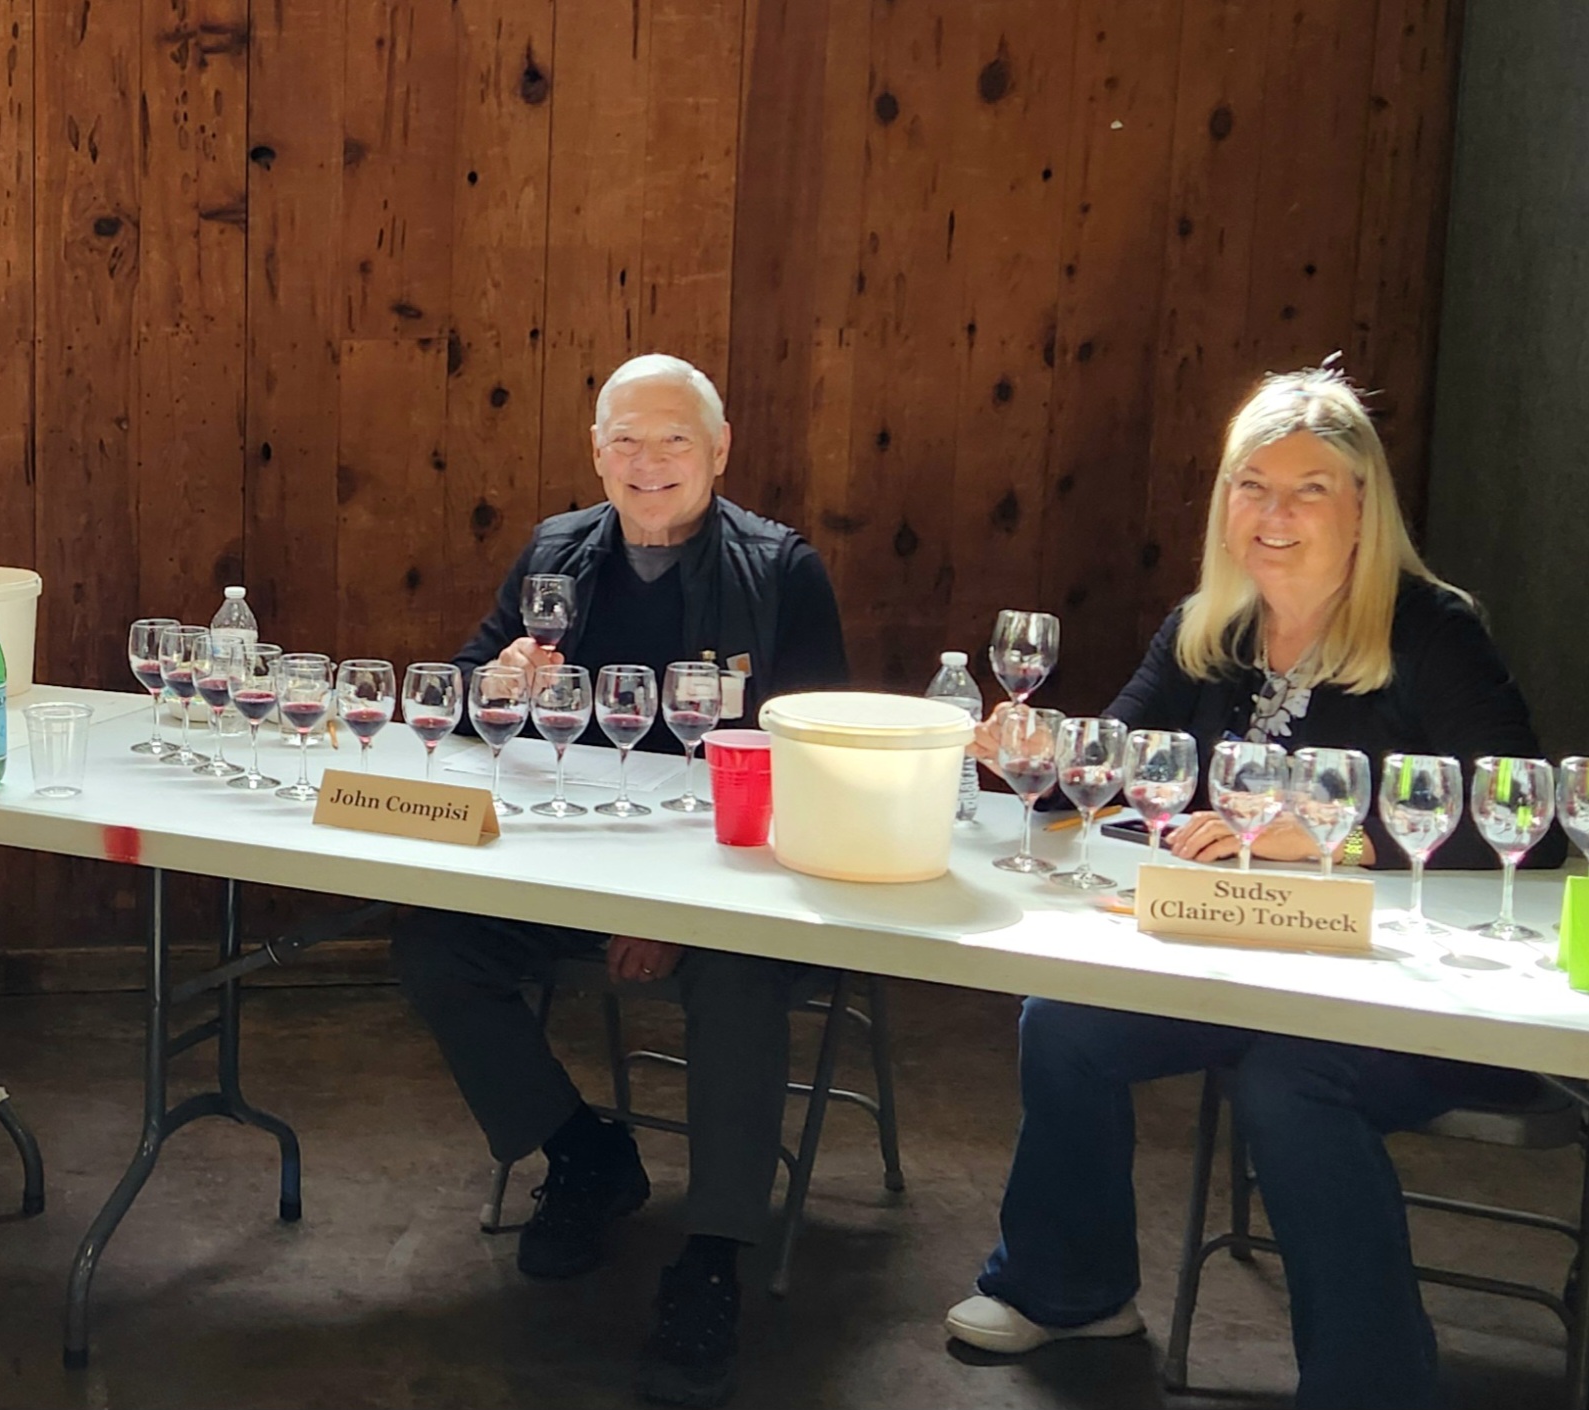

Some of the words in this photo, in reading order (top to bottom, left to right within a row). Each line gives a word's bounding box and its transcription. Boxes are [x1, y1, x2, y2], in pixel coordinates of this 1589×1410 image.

[330, 788, 380, 810] John
[385, 795, 470, 822] Compisi
[1213, 879, 1293, 907] Sudsy
[1149, 898, 1246, 926] (Claire)
[1251, 907, 1359, 934] Torbeck
